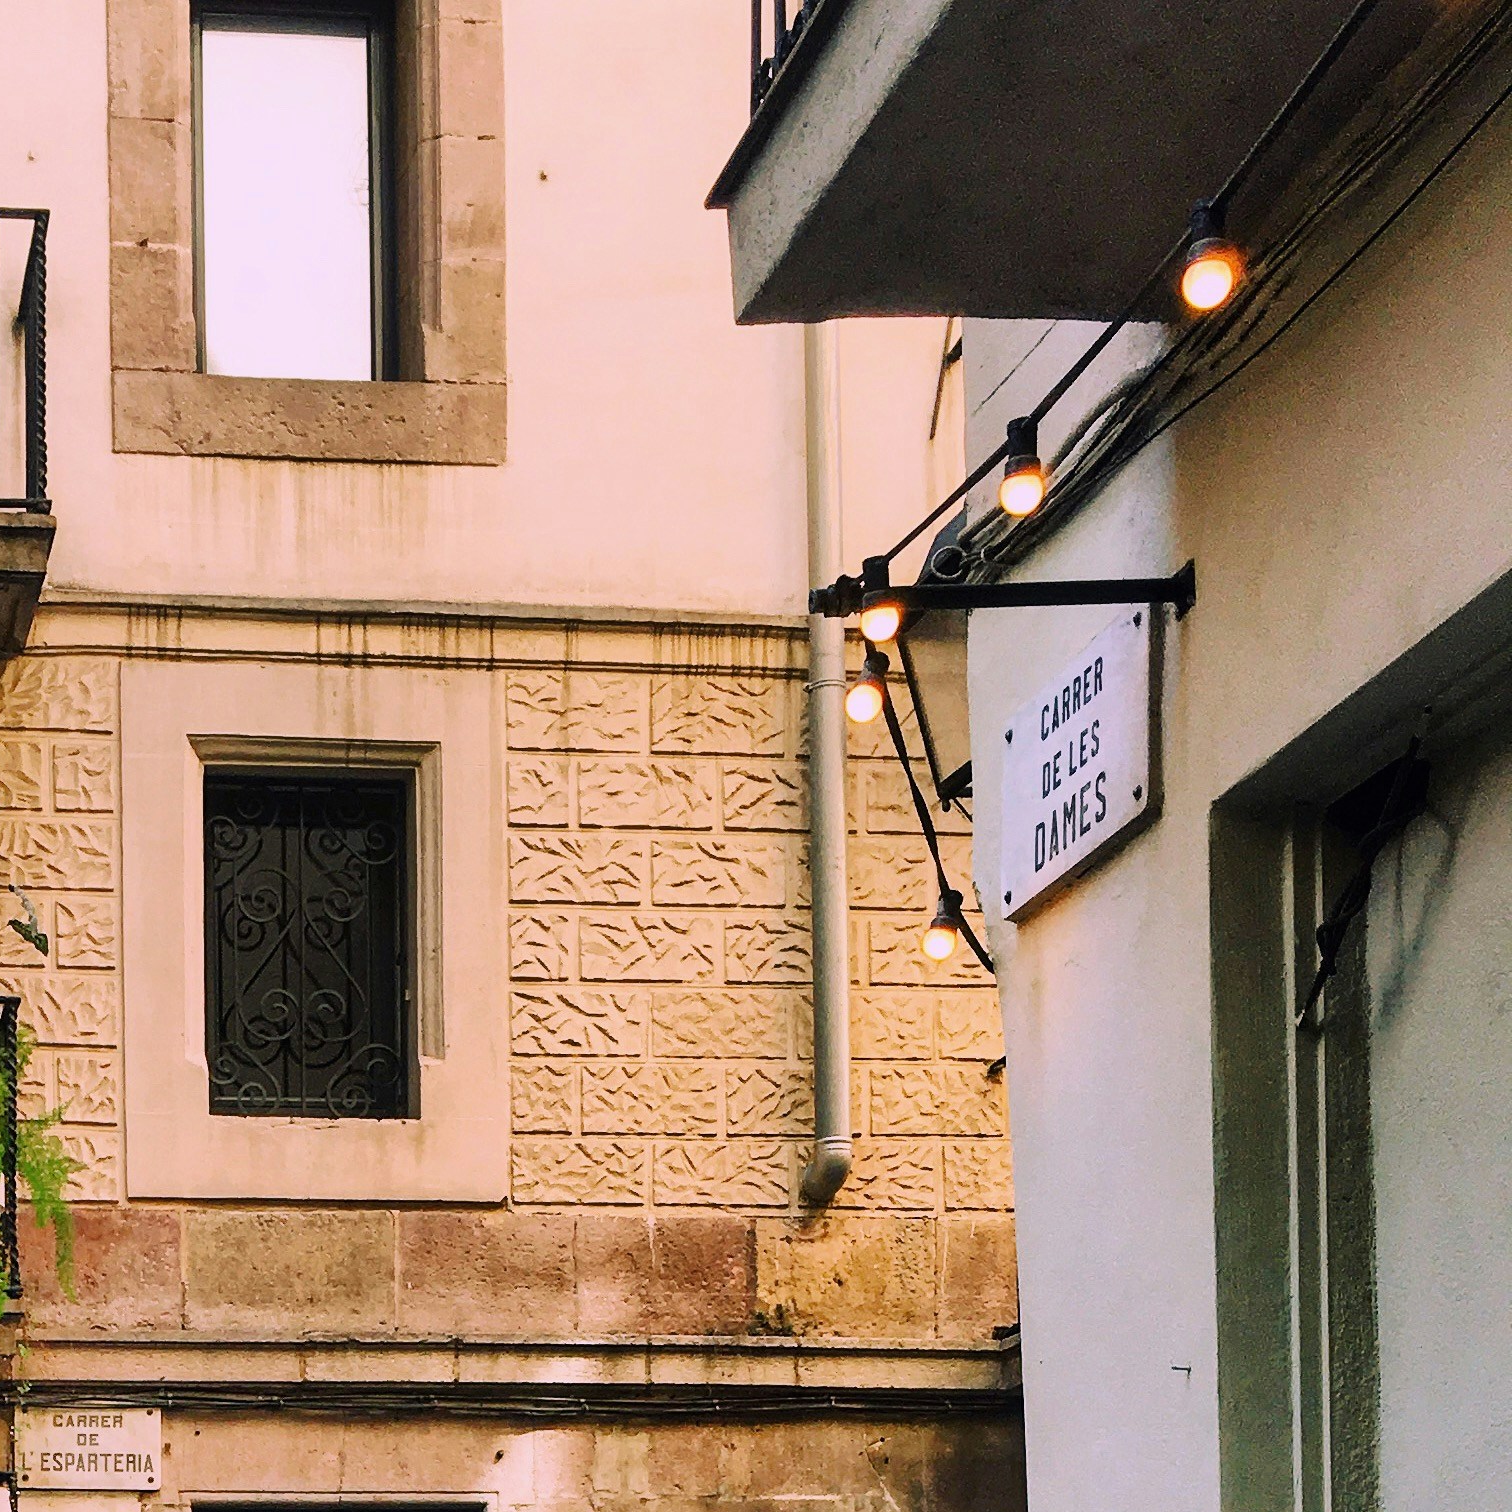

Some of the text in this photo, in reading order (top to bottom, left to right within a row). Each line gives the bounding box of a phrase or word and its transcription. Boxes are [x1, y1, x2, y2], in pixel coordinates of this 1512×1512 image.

[1040, 656, 1104, 742] CARRER
[1042, 719, 1100, 800] DE LES
[1034, 770, 1107, 874] DAMES
[52, 1414, 124, 1429] CARRER
[76, 1433, 100, 1447] DE
